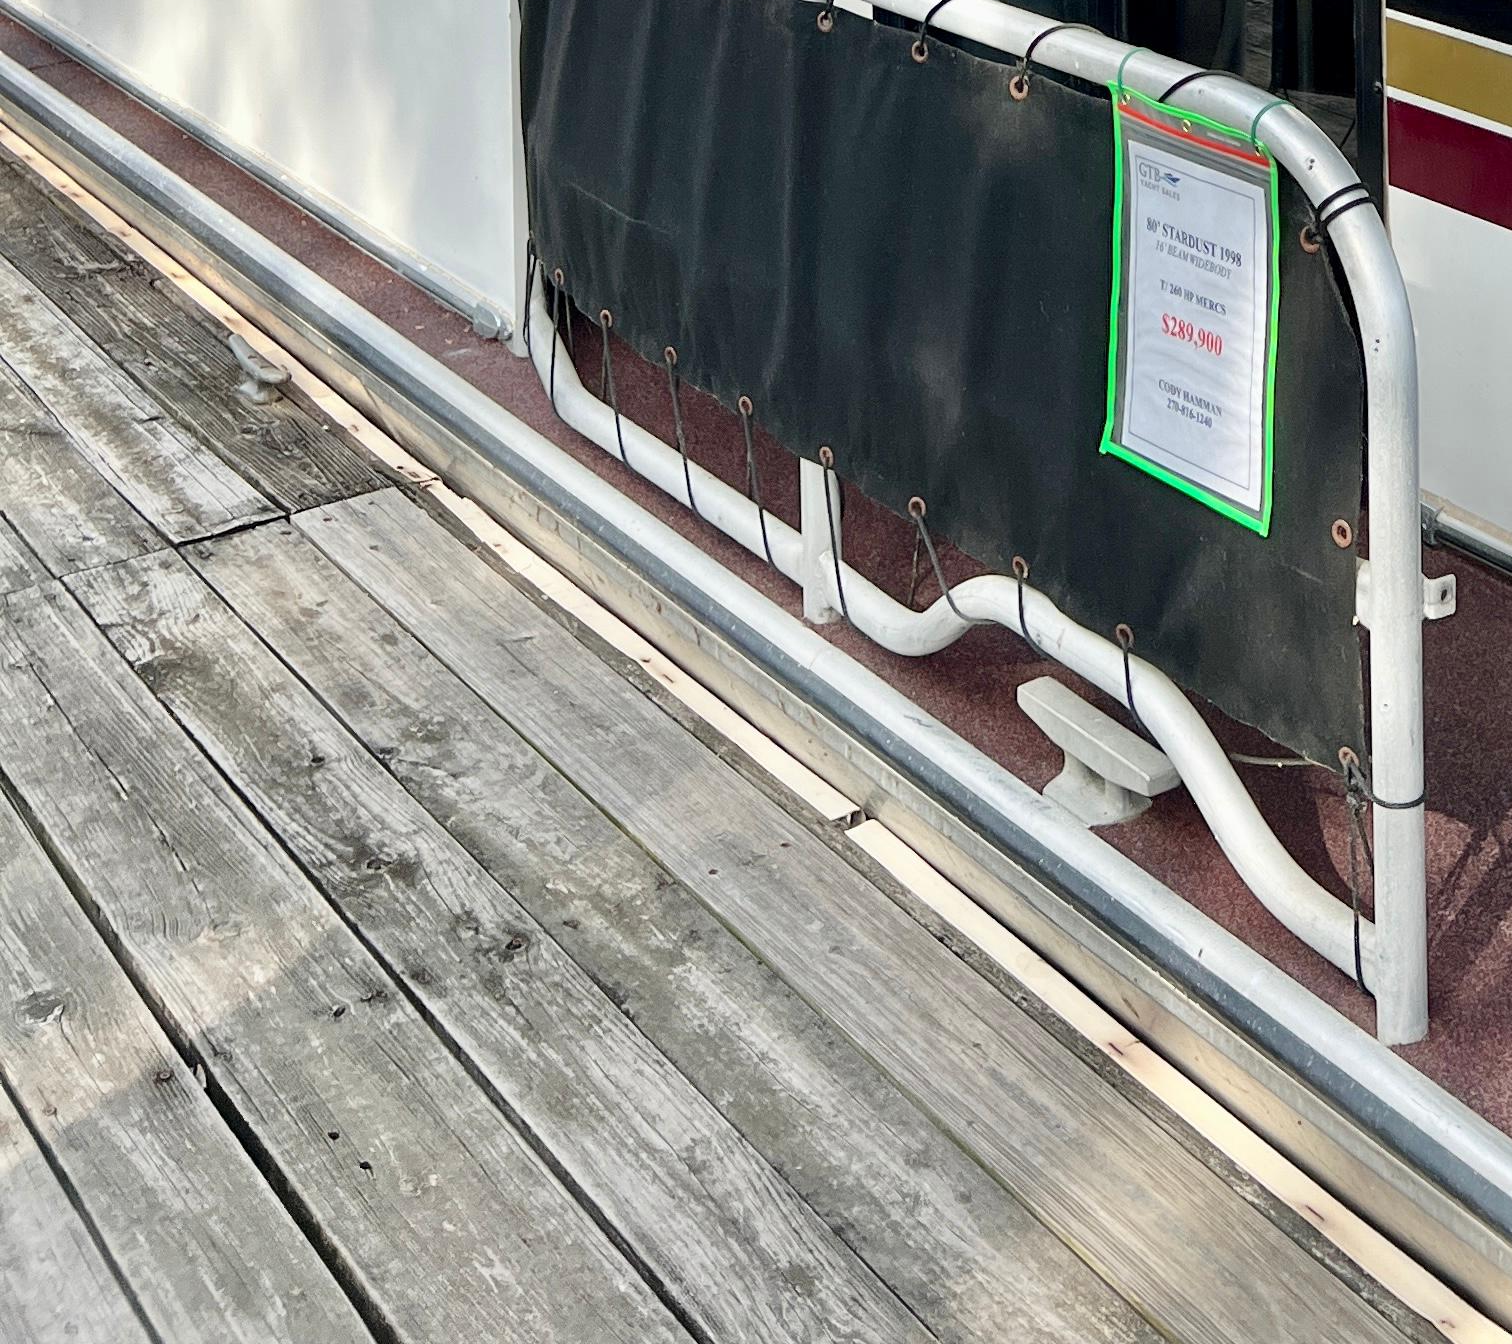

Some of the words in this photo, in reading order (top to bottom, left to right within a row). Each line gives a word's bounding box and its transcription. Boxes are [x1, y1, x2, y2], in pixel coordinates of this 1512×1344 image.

[1139, 161, 1161, 183] GTB
[1140, 178, 1160, 192] YACHT
[1161, 185, 1181, 201] SALES
[1161, 222, 1218, 258] STARDUST
[1219, 245, 1243, 268] 1998
[1167, 244, 1190, 263] BEAM
[1189, 253, 1233, 280] WIDEBODY
[1169, 283, 1183, 298] 260
[1183, 287, 1195, 302] HP
[1195, 293, 1227, 316] MERCS
[1161, 312, 1224, 357] $289,900
[1158, 378, 1182, 398] CODY
[1182, 389, 1223, 417] HAMMAN
